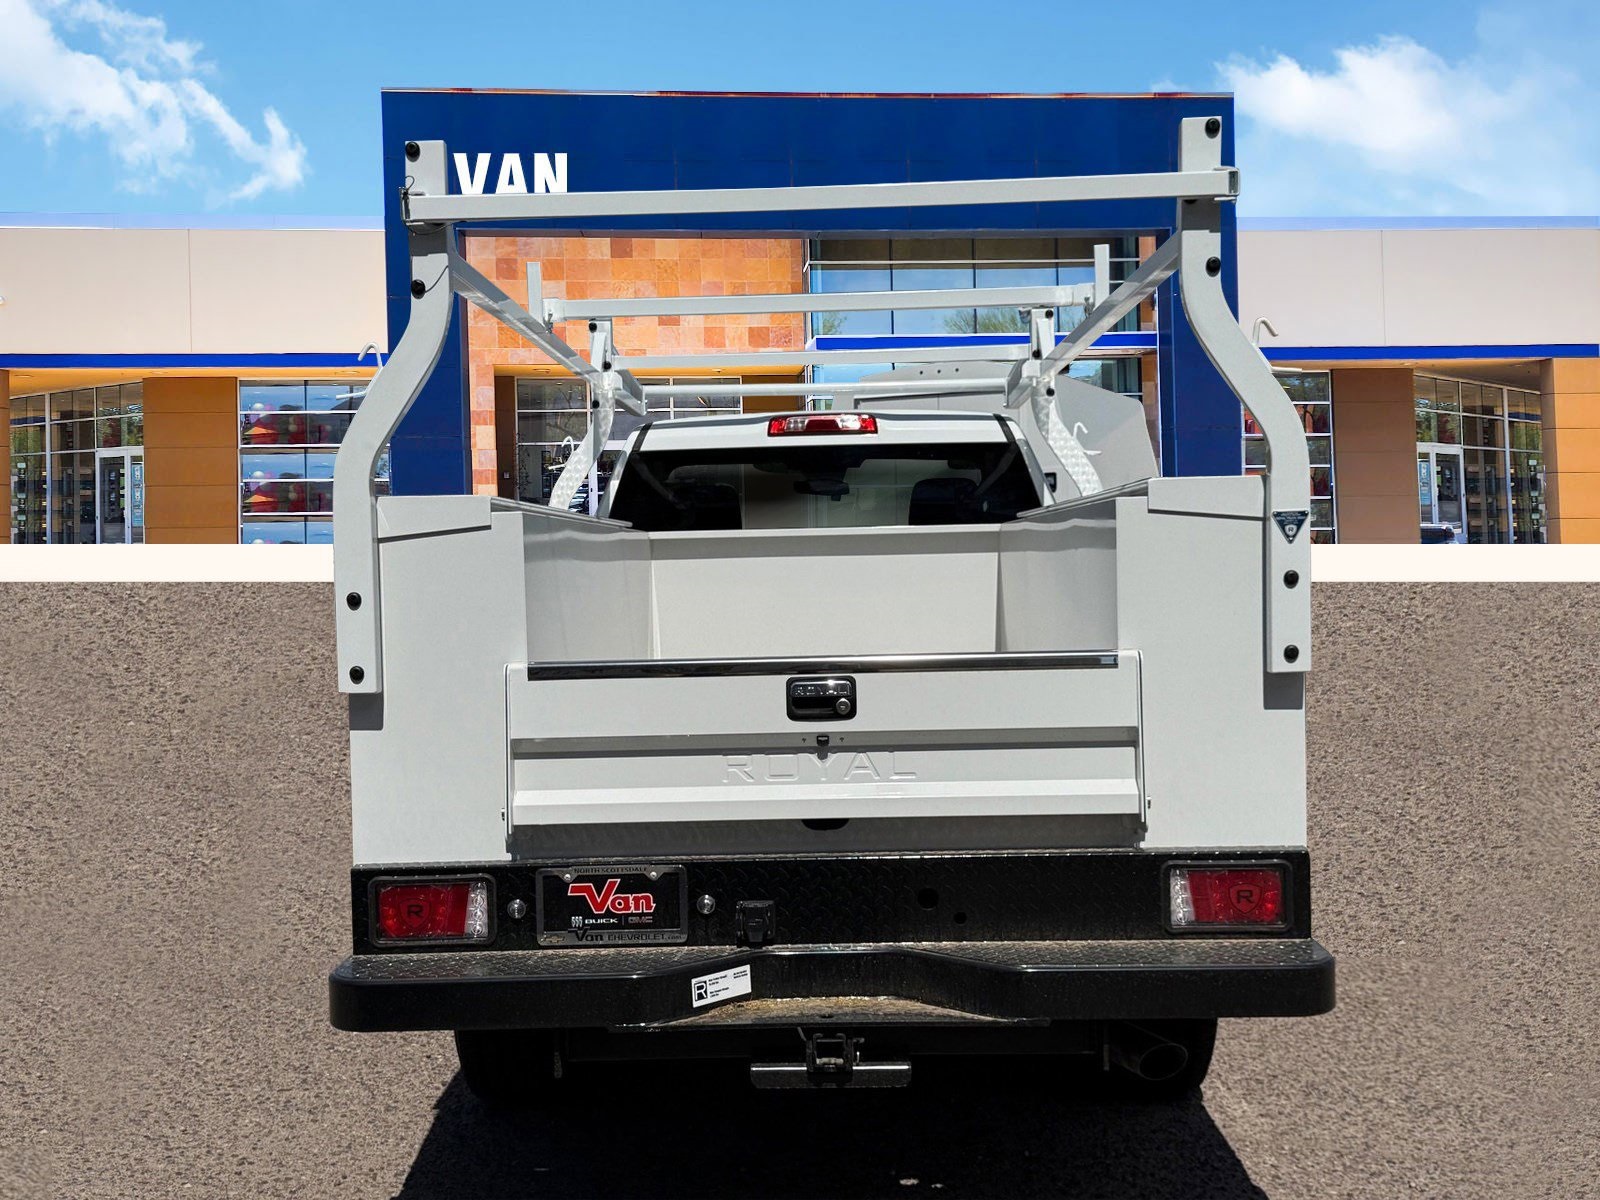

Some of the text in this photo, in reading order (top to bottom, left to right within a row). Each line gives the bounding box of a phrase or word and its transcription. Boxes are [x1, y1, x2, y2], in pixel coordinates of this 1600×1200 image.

[453, 153, 568, 195] VAN
[722, 752, 917, 782] ROYAL
[568, 879, 656, 914] Van
[568, 926, 604, 942] Van
[694, 982, 707, 1000] R
